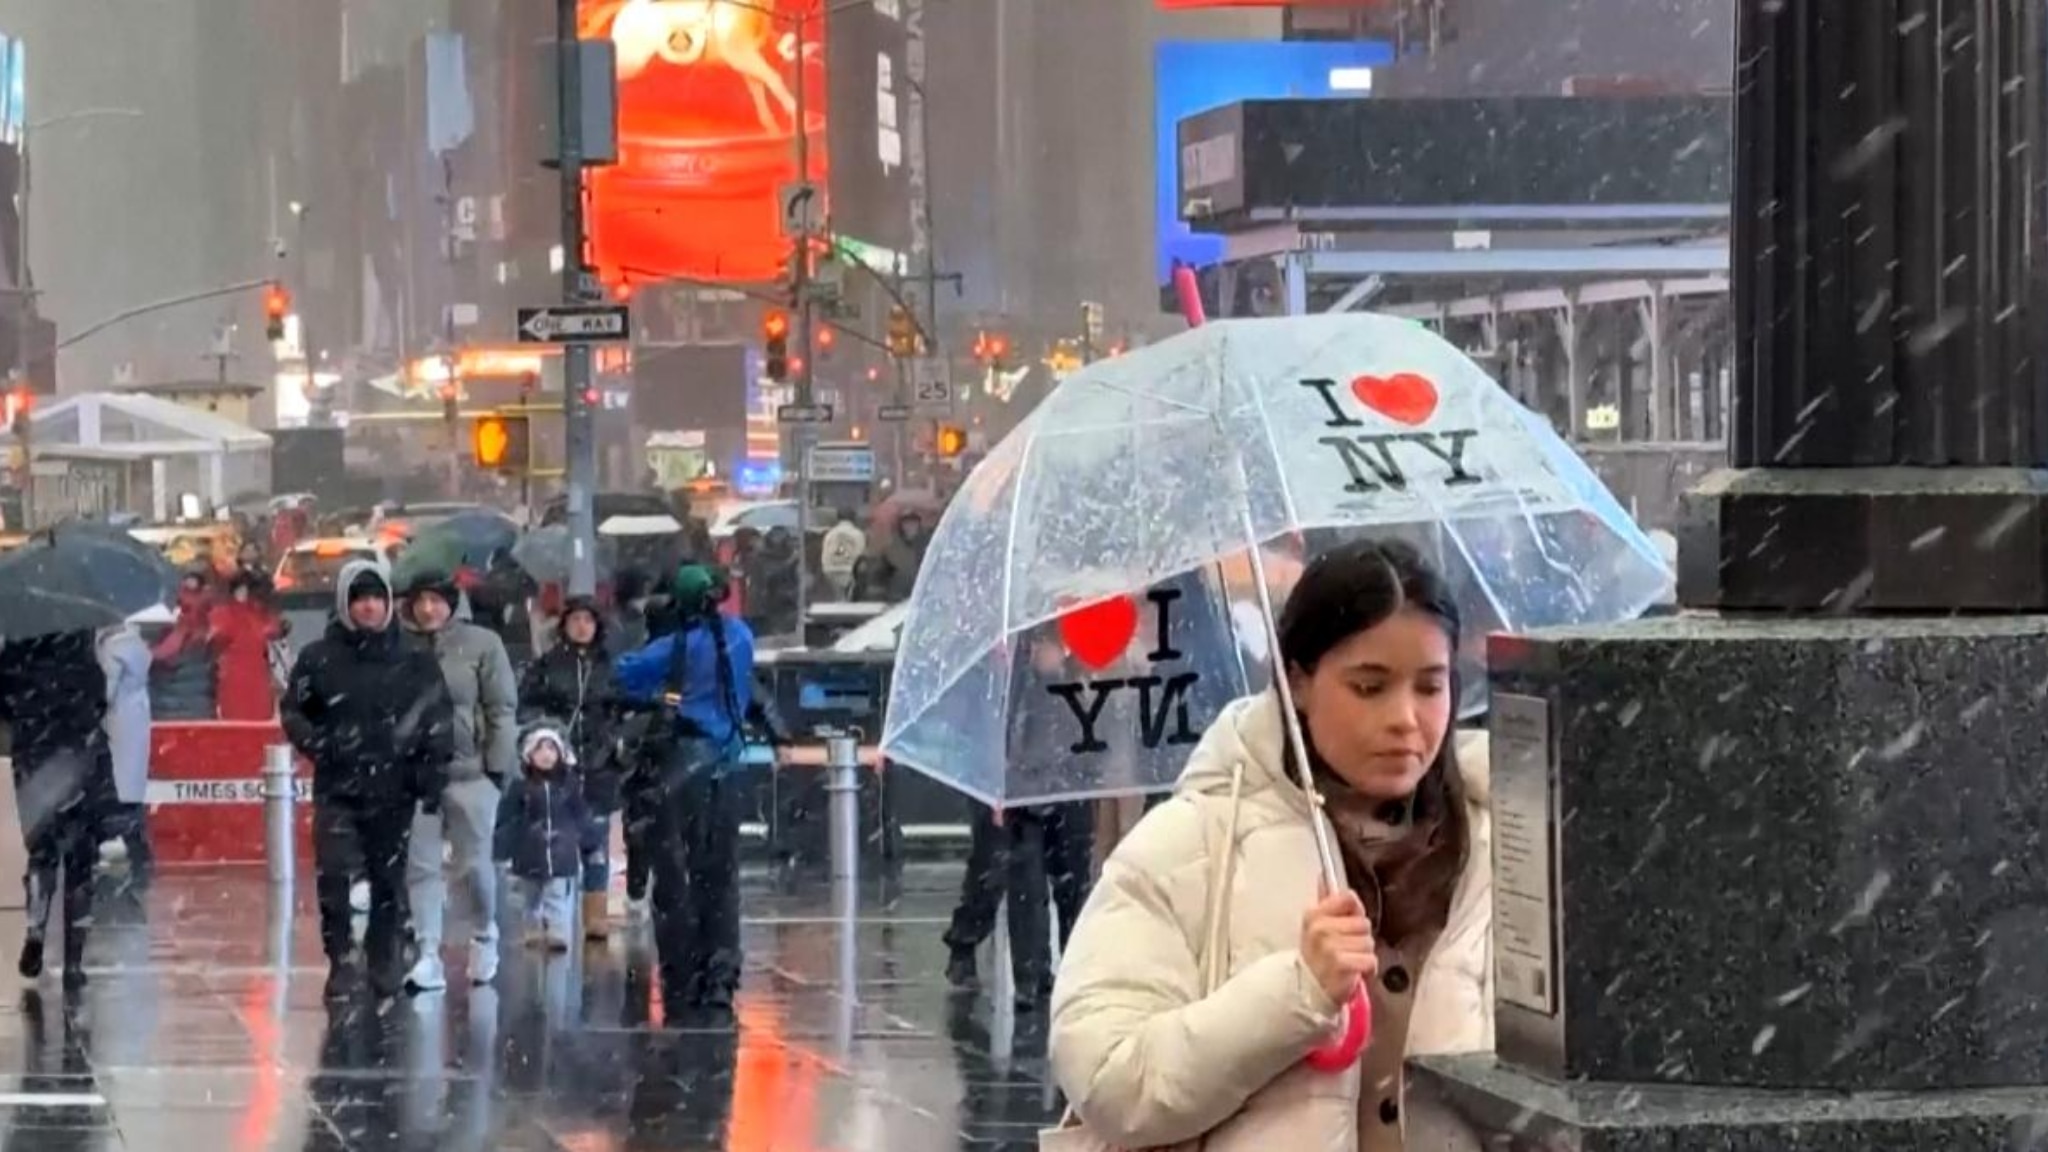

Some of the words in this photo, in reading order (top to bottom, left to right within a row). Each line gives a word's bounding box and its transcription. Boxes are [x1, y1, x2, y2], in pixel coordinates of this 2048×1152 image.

[582, 317, 614, 332] WAY
[918, 380, 948, 400] 25
[1299, 378, 1364, 427] I
[1318, 429, 1482, 493] NY
[174, 782, 237, 799] TIMES
